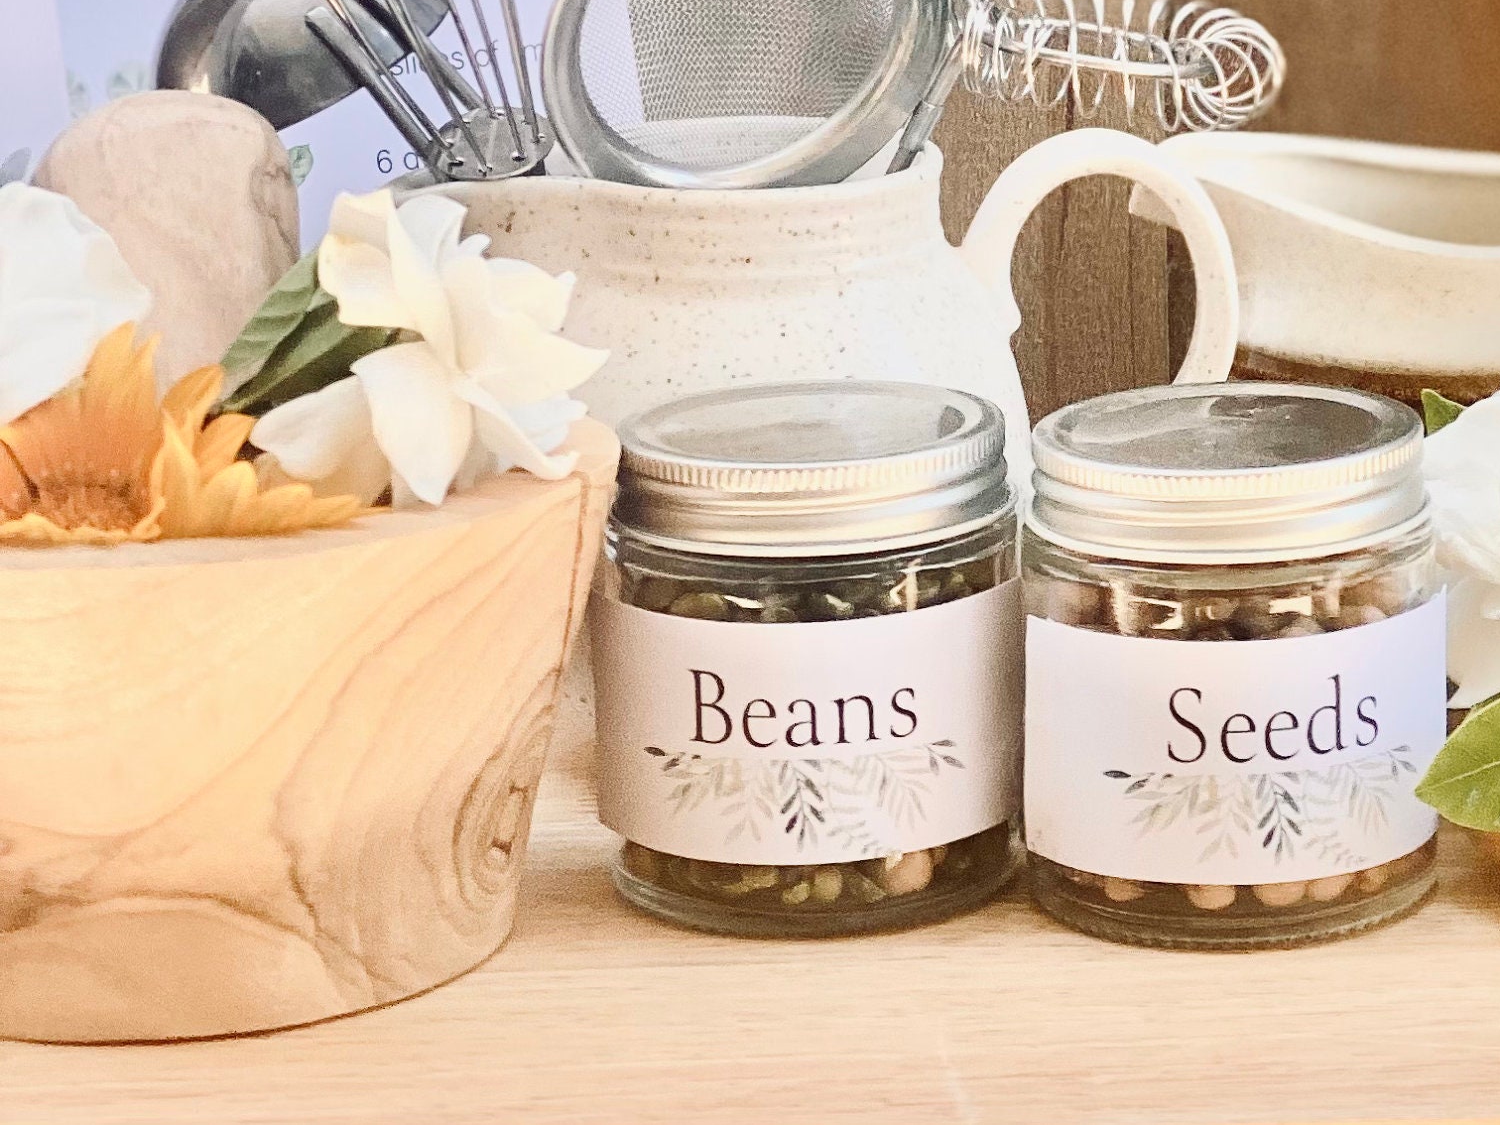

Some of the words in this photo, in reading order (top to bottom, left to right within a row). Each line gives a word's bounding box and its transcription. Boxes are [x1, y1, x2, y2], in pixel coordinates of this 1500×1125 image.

[474, 39, 499, 67] of
[376, 148, 393, 174] 6
[689, 668, 919, 749] Beans
[1166, 675, 1381, 763] Seeds
